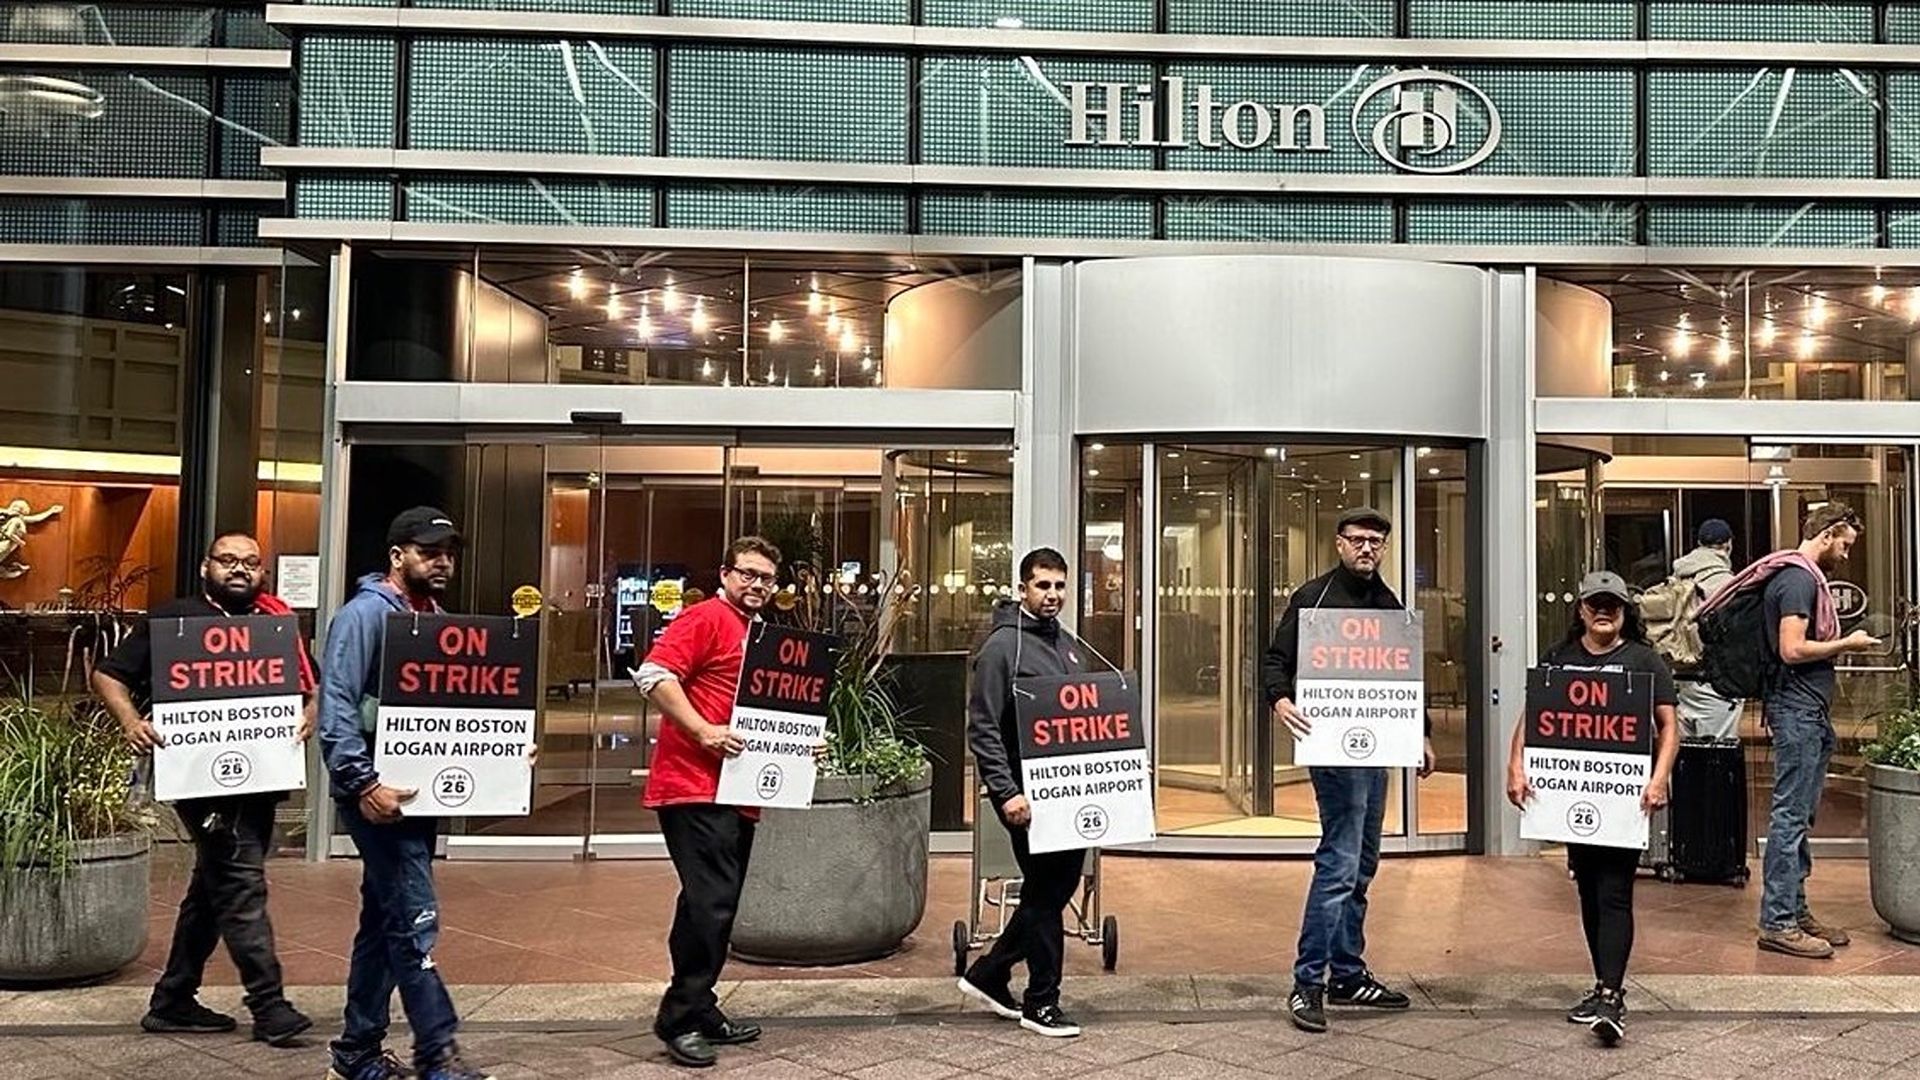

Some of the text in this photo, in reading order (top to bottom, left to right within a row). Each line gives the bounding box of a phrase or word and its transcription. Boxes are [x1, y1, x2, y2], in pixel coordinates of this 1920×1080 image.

[1063, 75, 1331, 151] Hilton
[1342, 617, 1381, 640] ON
[204, 626, 249, 654] ON
[439, 626, 488, 656] ON
[779, 638, 809, 667] ON
[1312, 645, 1411, 670] STRIKE
[170, 658, 285, 690] STRIKE
[399, 662, 521, 695] STRIKE
[750, 668, 824, 702] STRIKE
[1059, 683, 1099, 710] ON
[1303, 688, 1417, 701] HILTON BOSTON
[1568, 680, 1608, 706] ON
[162, 705, 295, 726] HILTON BOSTON
[1302, 706, 1418, 719] LOGAN AIRPORT
[226, 725, 296, 743] AIRPORT
[386, 717, 526, 734] HILTON BOSTON
[736, 716, 821, 738] HILTON BOSTON
[1033, 713, 1131, 746] STRIKE
[1538, 711, 1637, 742] STRIKE
[384, 742, 526, 757] LOGAN AIRPORT
[1350, 738, 1368, 748] 26
[221, 763, 242, 776] 26
[1029, 759, 1142, 781] HILTON BOSTON
[1530, 756, 1644, 776] HILTON BOSTON
[442, 781, 465, 793] 26
[762, 776, 776, 787] 26
[1031, 778, 1144, 801] LOGAN AIRPORT
[1581, 781, 1644, 797] AIRPORT
[1083, 816, 1101, 828] 26
[1575, 813, 1593, 825] 26
